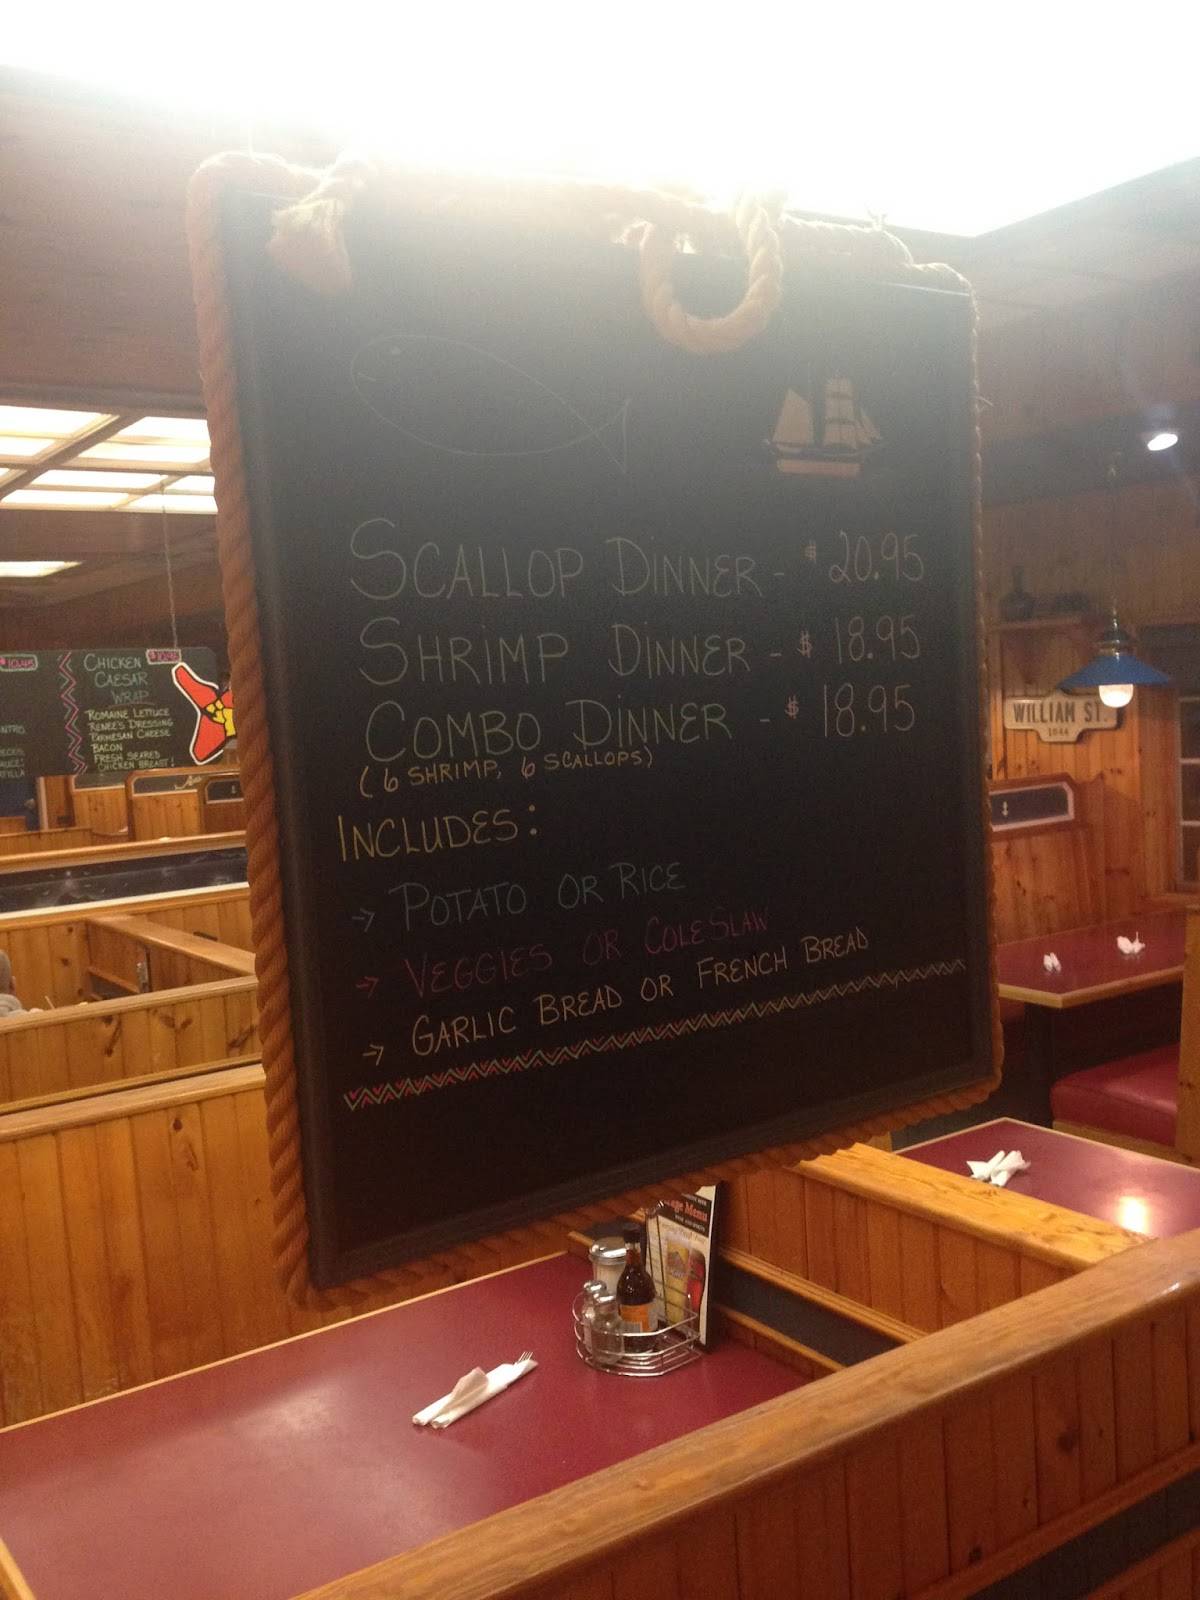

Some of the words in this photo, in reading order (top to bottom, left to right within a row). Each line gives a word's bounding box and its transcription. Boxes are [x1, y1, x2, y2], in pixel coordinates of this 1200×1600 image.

[351, 518, 583, 600] SCALLOP
[606, 536, 763, 597] DINNER
[829, 530, 925, 583] 20.95
[84, 653, 142, 672] CHICKEN
[95, 671, 148, 688] CAESAR
[360, 617, 569, 686] SHRIMP
[608, 620, 751, 679] DINNER
[836, 614, 921, 664] 18.95
[366, 700, 541, 762] COMBO
[565, 694, 733, 748] DINNER
[823, 683, 916, 738] 18.95
[1013, 701, 1076, 723] WILLIAM
[91, 743, 123, 754] BACON
[388, 882, 527, 932] POTATO
[558, 873, 604, 909] OR
[609, 862, 686, 899] RICE
[404, 944, 553, 998] VEGGIES
[582, 929, 622, 966] OR
[412, 1006, 517, 1056] GARLIC
[532, 985, 624, 1025] BREAD
[639, 974, 674, 1002] OR
[696, 946, 789, 989] FRENCH
[800, 926, 871, 964] BREAD
